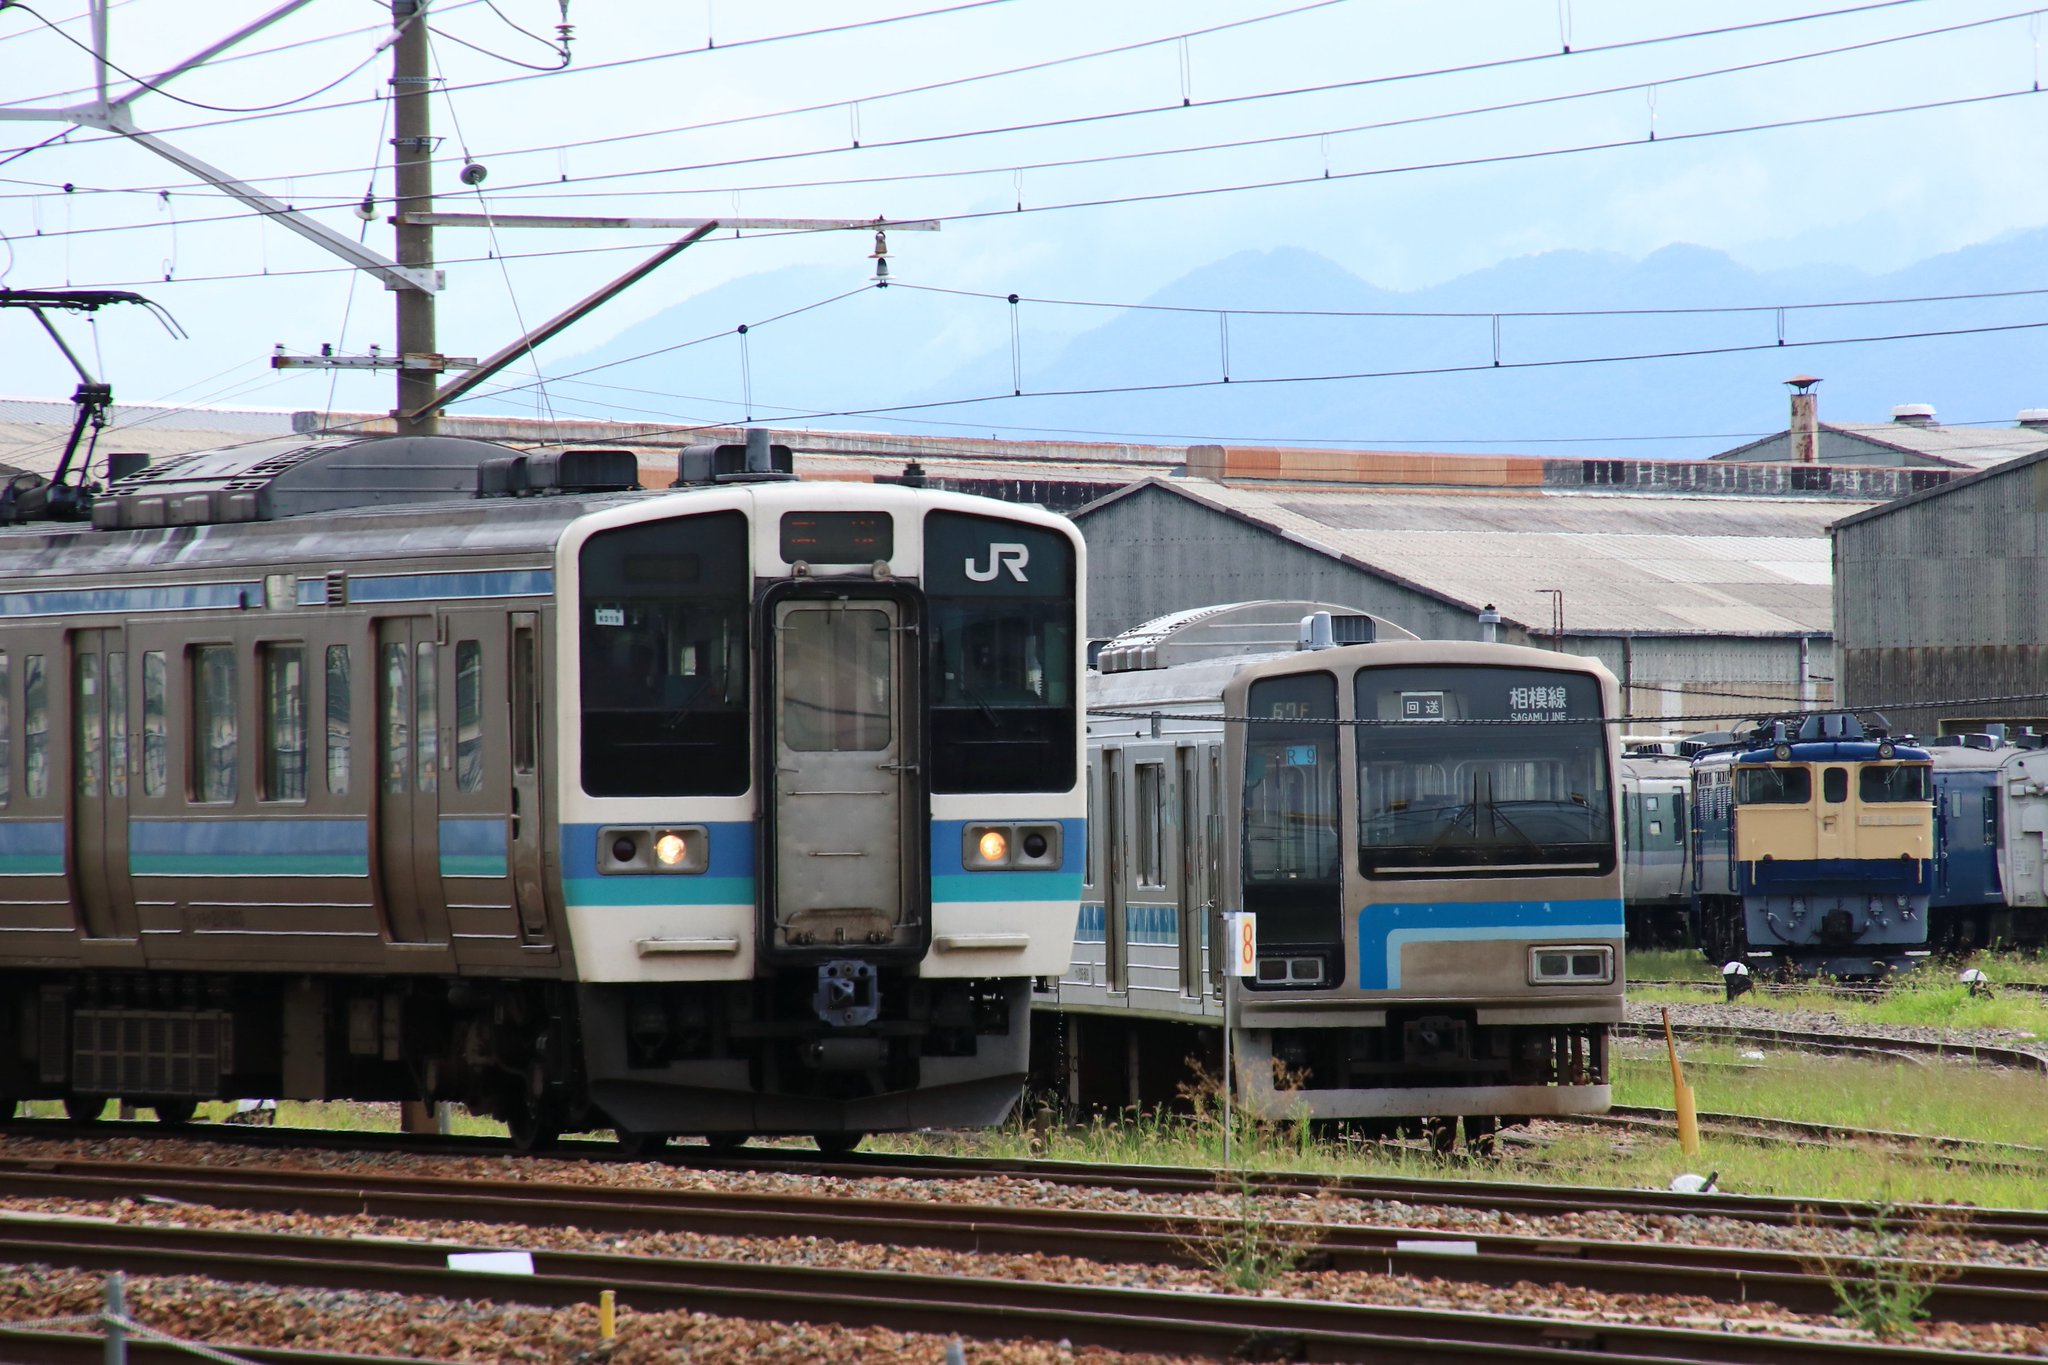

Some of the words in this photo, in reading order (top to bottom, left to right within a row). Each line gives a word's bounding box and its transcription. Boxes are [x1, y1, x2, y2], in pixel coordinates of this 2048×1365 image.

[965, 543, 1029, 582] JR
[1509, 686, 1566, 709] 相模線
[1406, 701, 1439, 714] 回送
[1511, 712, 1543, 721] SAGAMI
[1546, 711, 1566, 721] LINE
[1287, 749, 1296, 764] R
[1306, 748, 1315, 763] 9
[1243, 923, 1253, 965] 8
